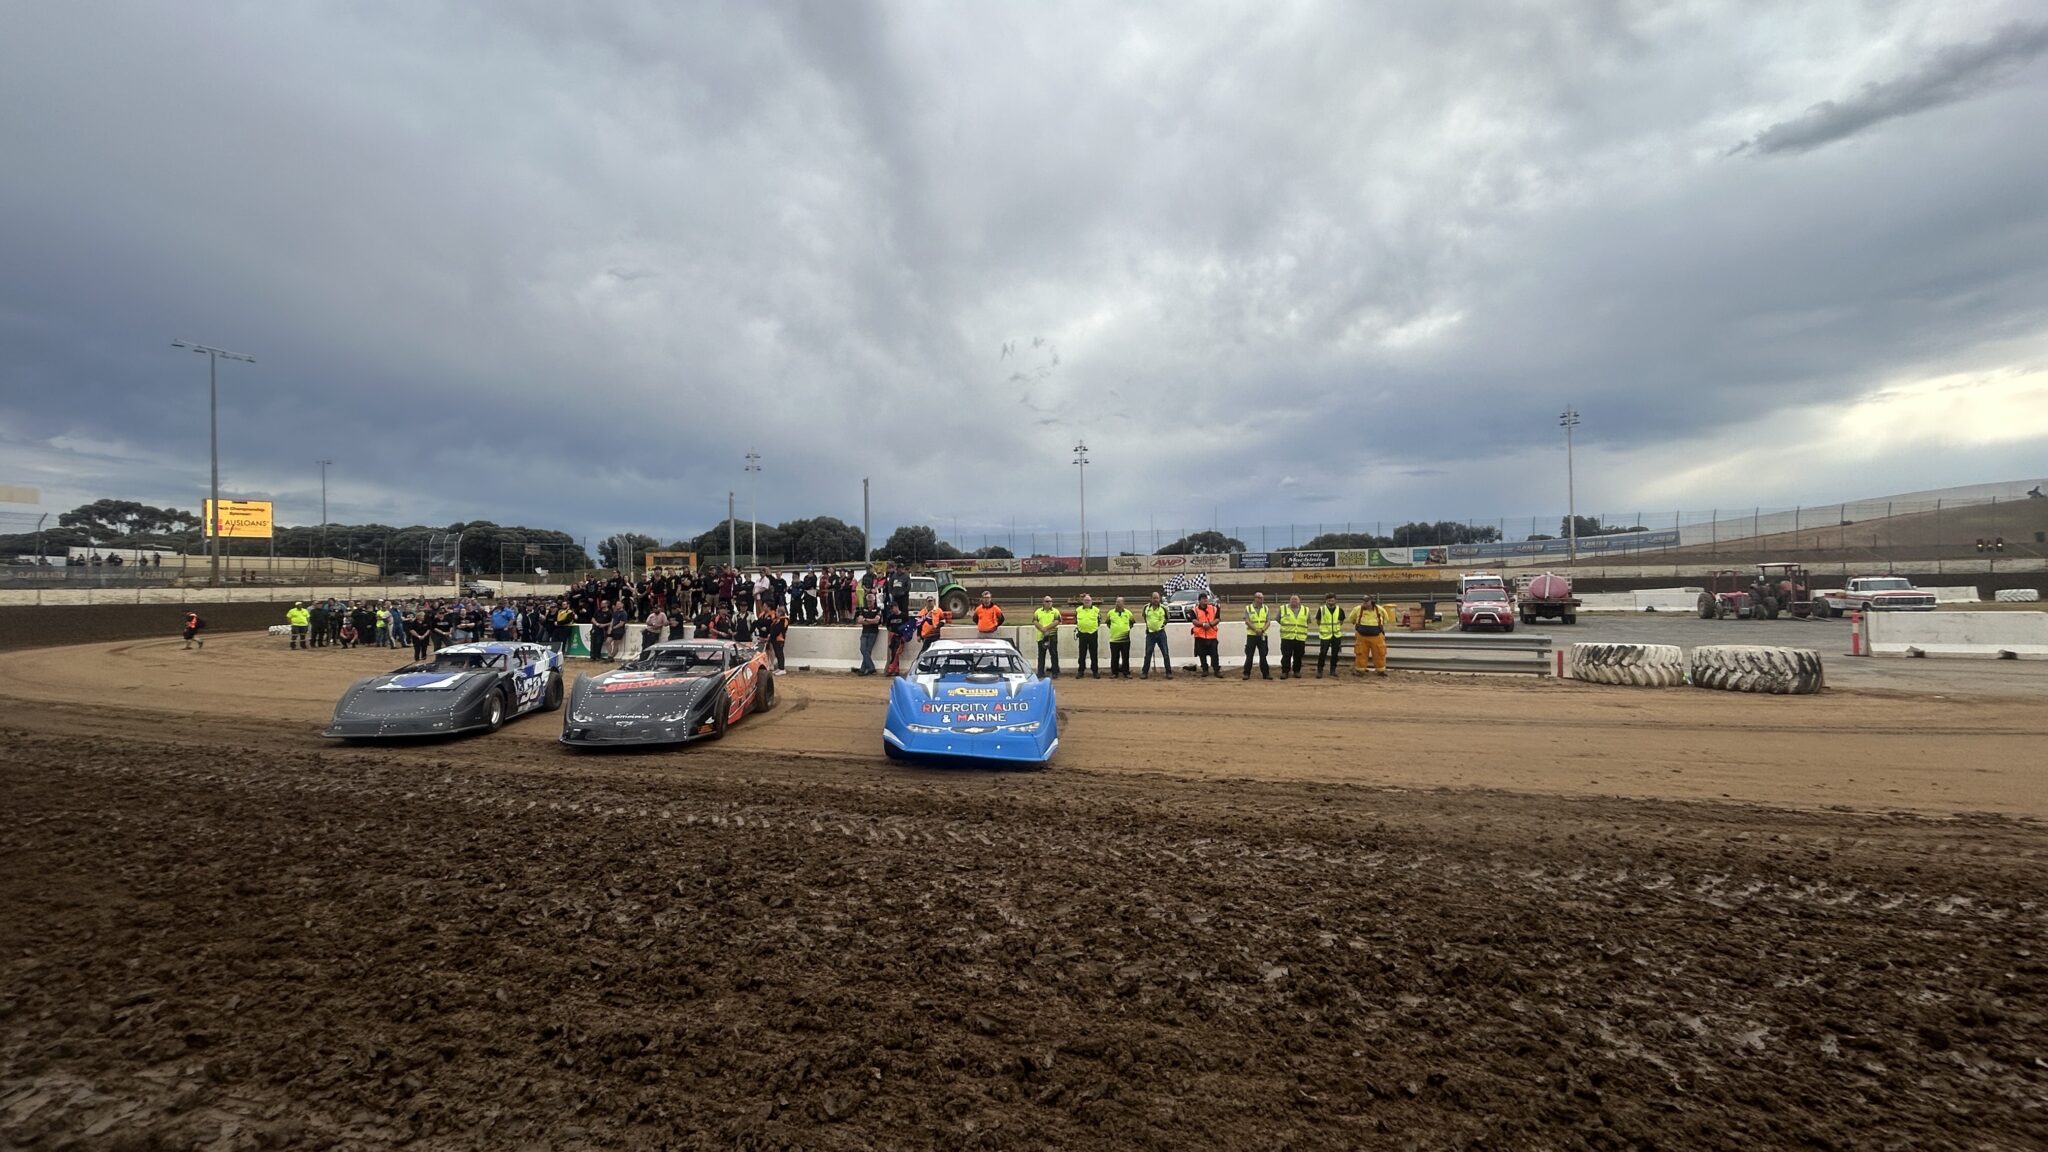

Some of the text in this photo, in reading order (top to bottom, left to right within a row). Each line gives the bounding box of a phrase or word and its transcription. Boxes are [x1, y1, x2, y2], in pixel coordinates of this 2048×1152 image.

[1154, 559, 1182, 567] AWP
[922, 702, 1029, 712] RIVERCITY AUTO
[942, 713, 1007, 723] & MARINE
